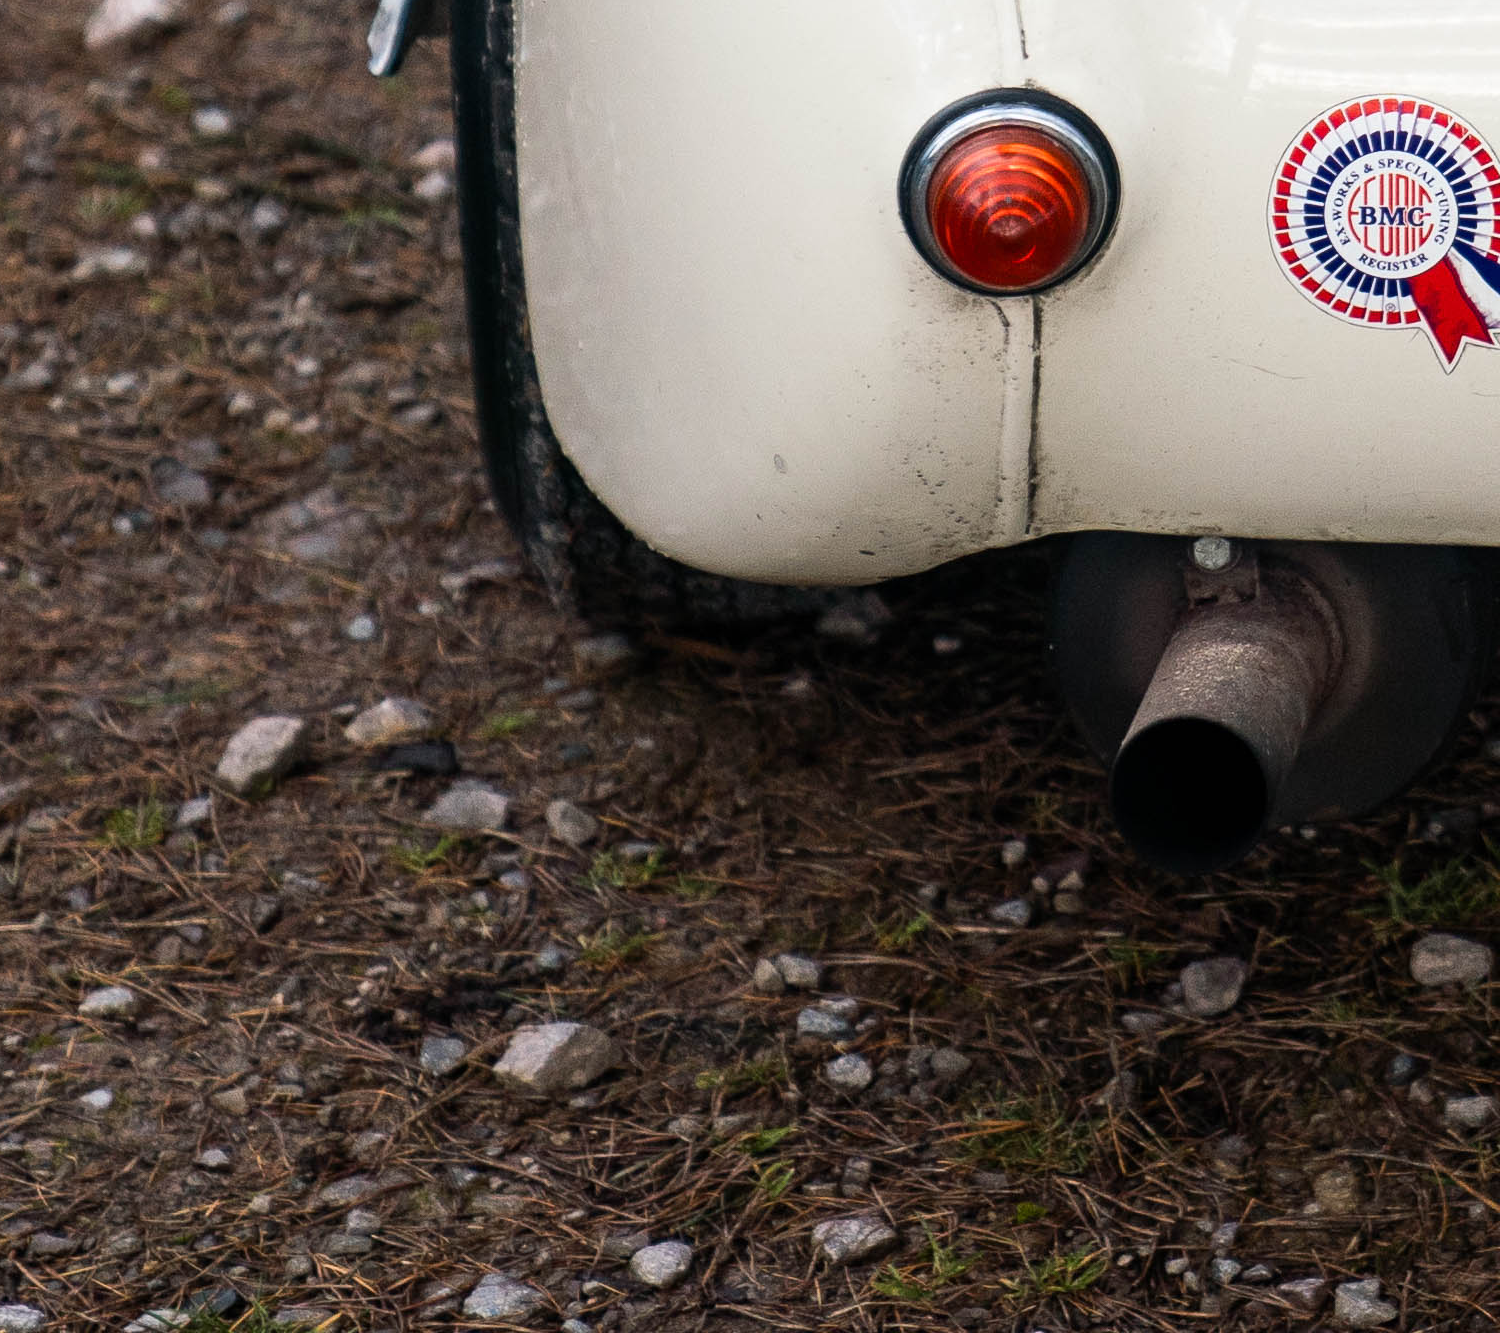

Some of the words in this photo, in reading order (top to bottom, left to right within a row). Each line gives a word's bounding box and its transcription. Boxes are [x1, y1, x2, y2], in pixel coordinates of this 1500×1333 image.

[1332, 170, 1361, 246] EX-WORKS
[1363, 163, 1374, 174] &
[1378, 158, 1436, 188] SPECIAL
[1434, 188, 1451, 245] TUNING
[1358, 205, 1425, 227] BMC
[1358, 252, 1429, 272] REGISTER
